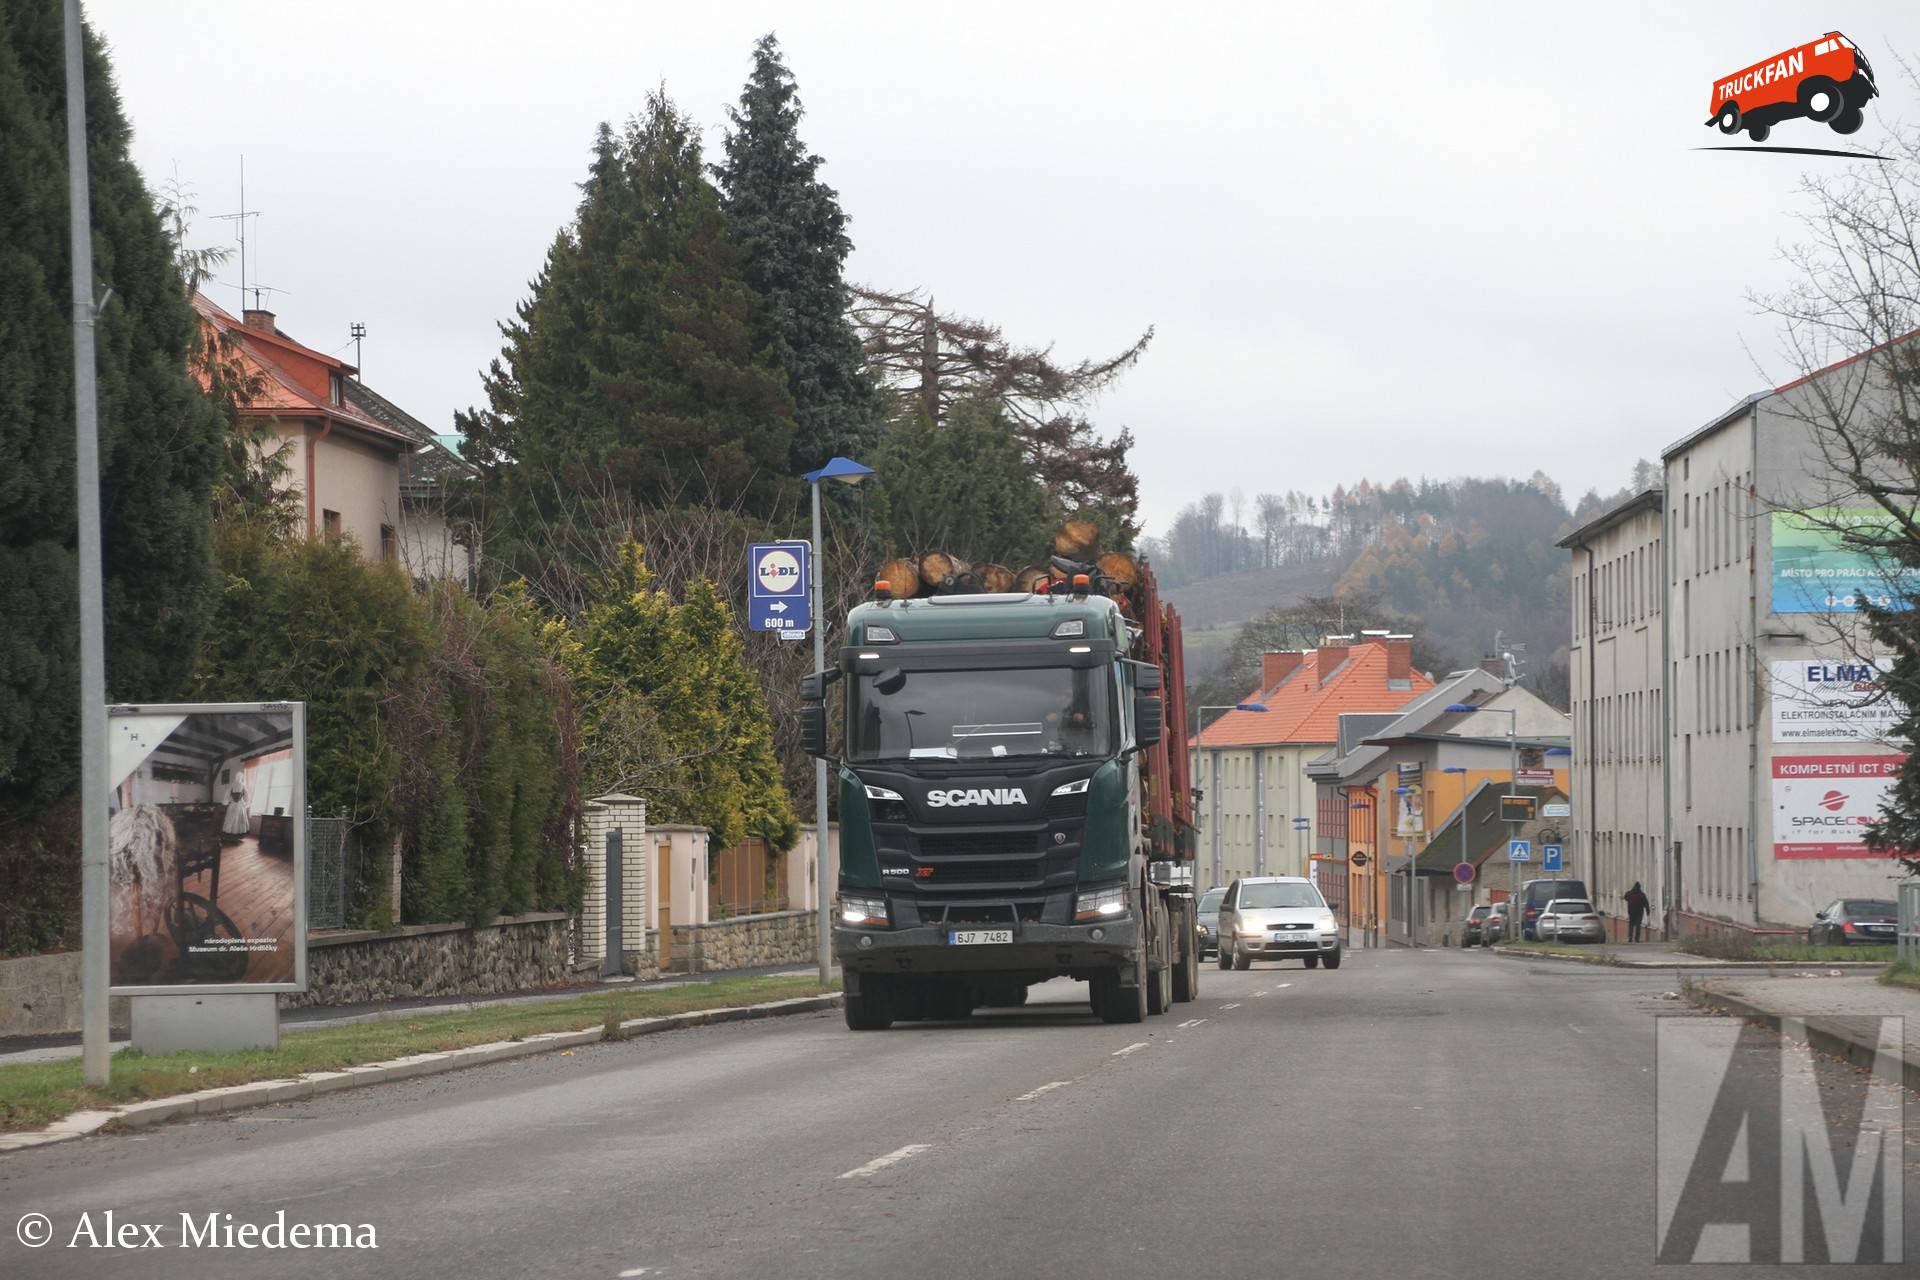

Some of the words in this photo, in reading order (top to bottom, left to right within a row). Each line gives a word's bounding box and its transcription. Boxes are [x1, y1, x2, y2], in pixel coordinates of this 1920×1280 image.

[764, 617, 784, 628] 600
[785, 619, 794, 628] m
[1807, 665, 1873, 682] ELMA
[1781, 709, 1877, 720] ELEKTROINSTALAČNÍM
[1781, 727, 1859, 738] www.elmaelektro.cz
[1780, 762, 1855, 775] KOMPLETNÍ
[1859, 763, 1879, 774] ICT
[927, 788, 1028, 808] SCANIA
[1546, 848, 1558, 863] P
[957, 932, 976, 944] 6J7
[983, 932, 1009, 944] 7482
